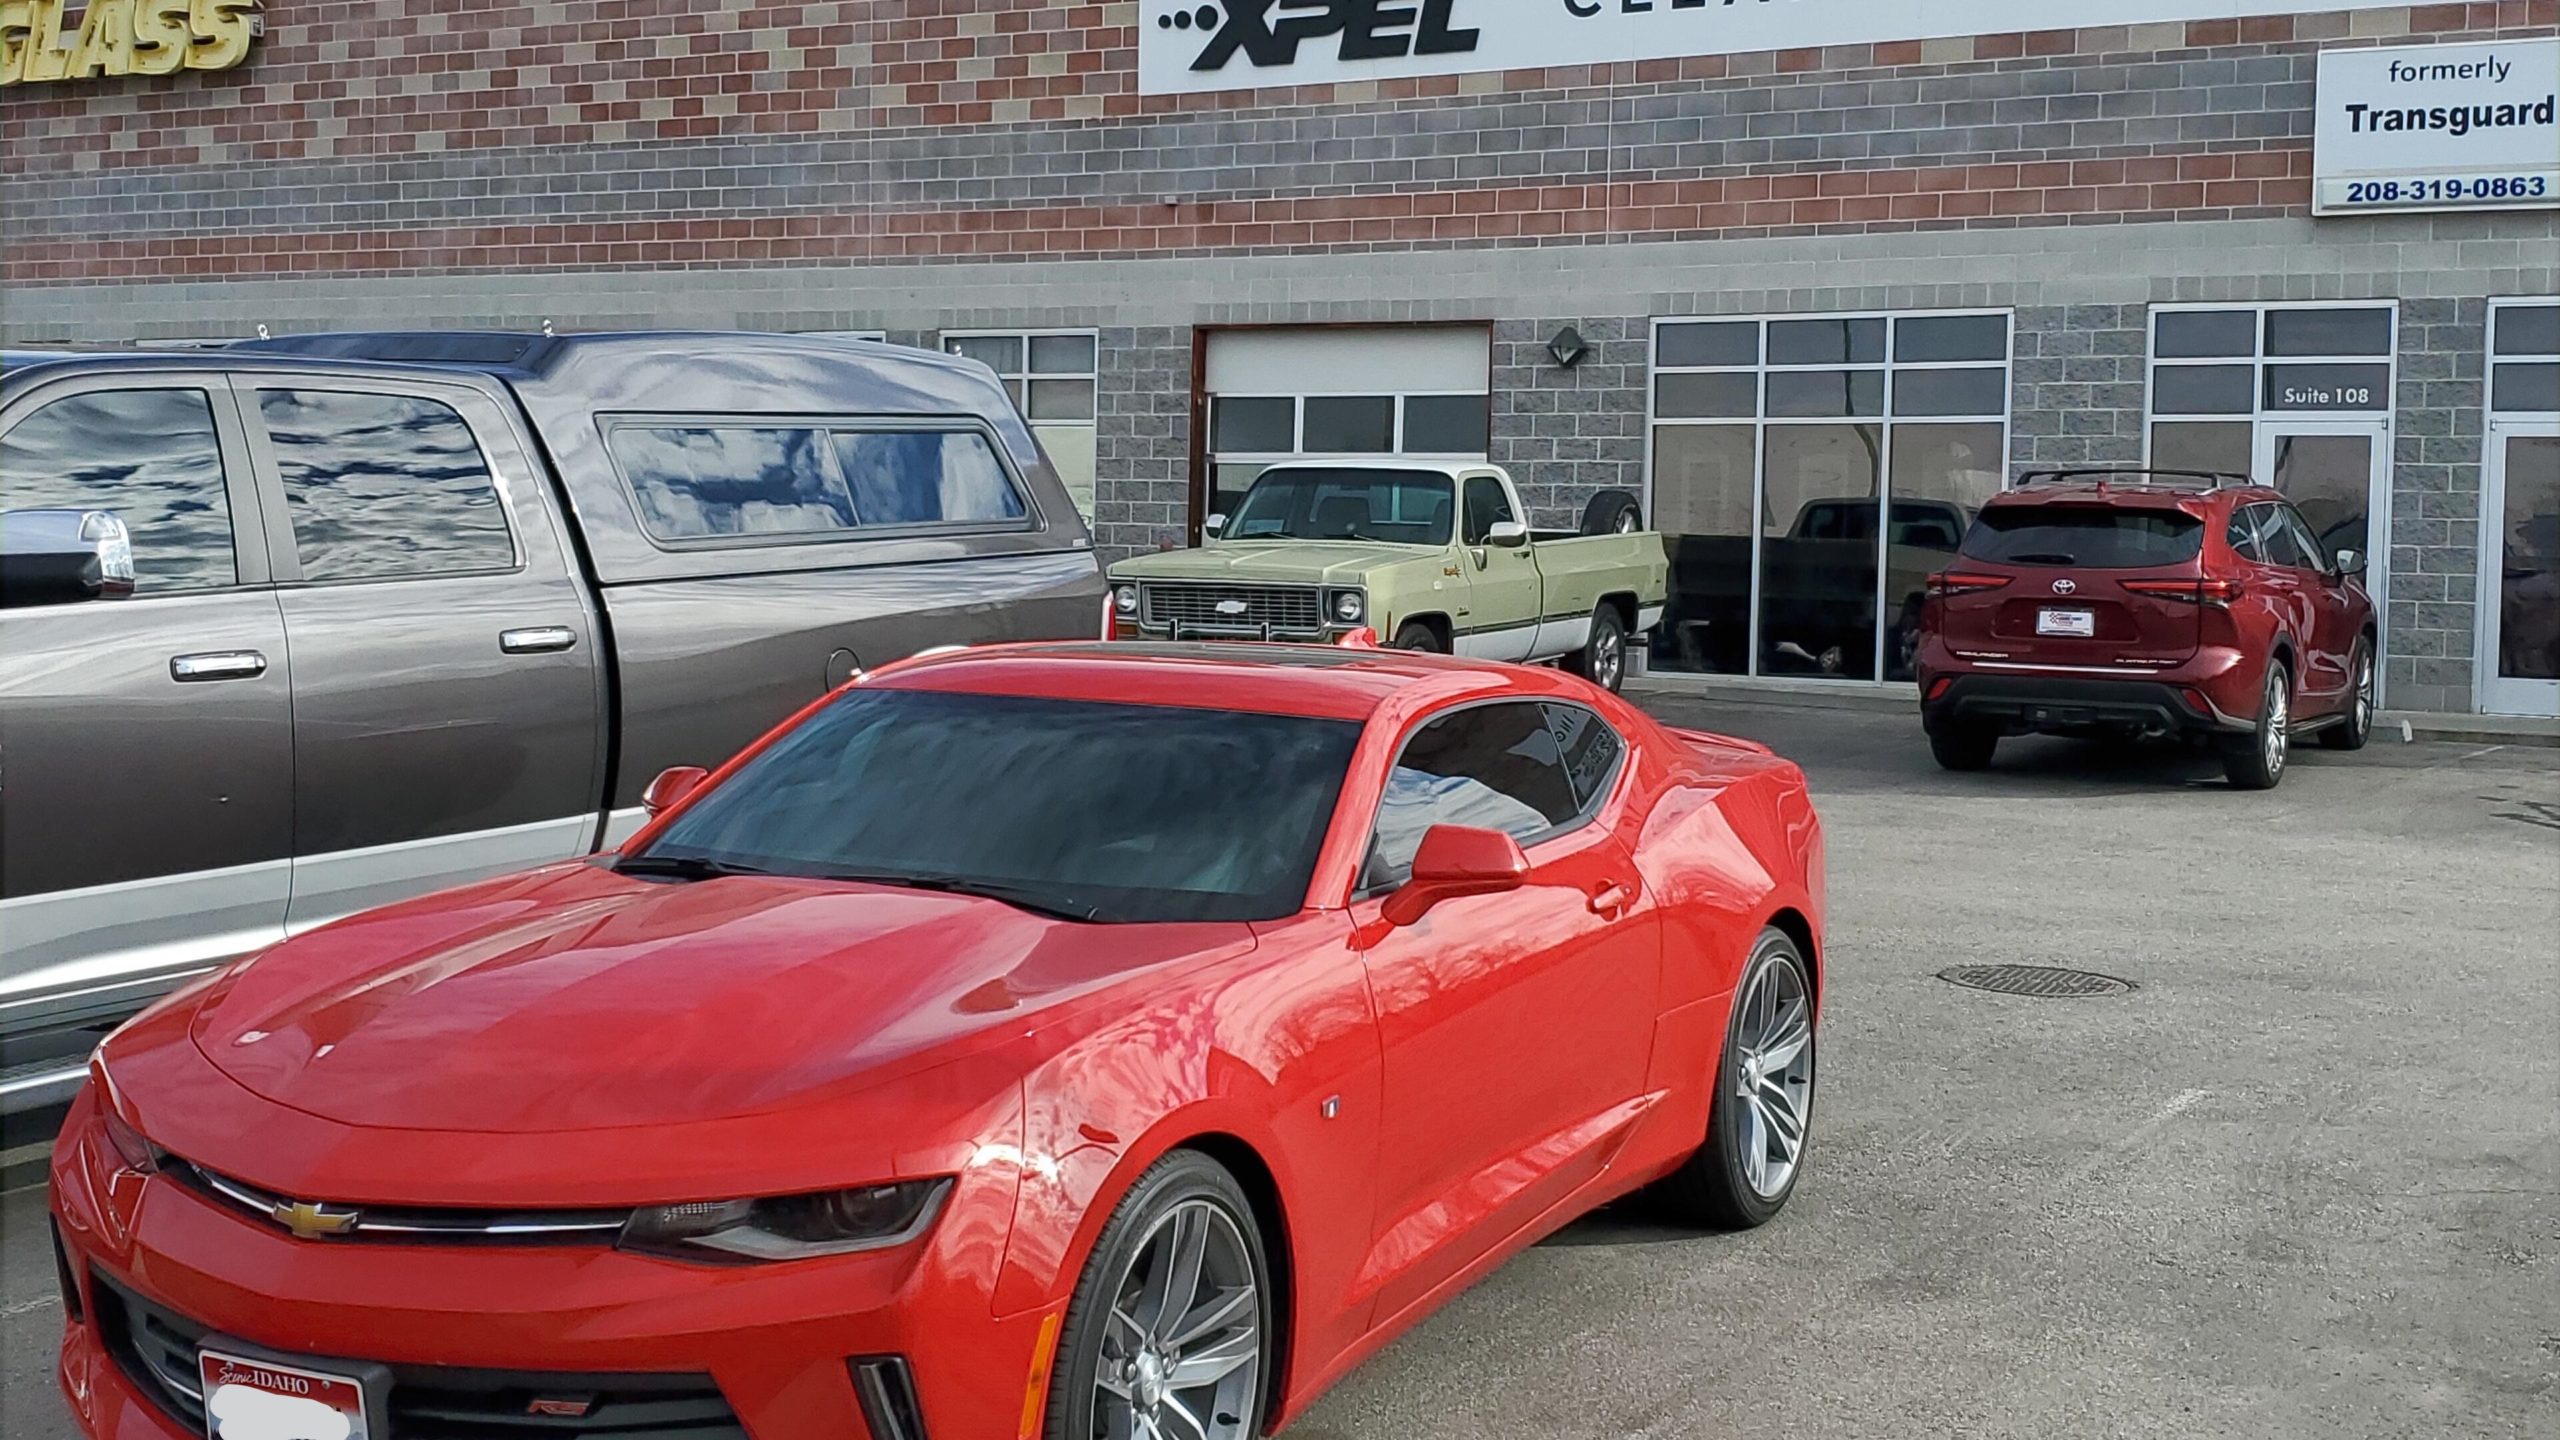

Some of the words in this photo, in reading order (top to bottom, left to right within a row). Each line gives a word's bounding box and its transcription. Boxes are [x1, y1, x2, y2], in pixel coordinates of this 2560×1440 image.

[1188, 0, 1480, 71] XPEL
[2389, 54, 2511, 83] formerly
[2345, 94, 2555, 136] Transguard
[2346, 176, 2546, 203] 208-319-0863
[2284, 387, 2329, 404] Suite
[2336, 388, 2369, 404] 108
[251, 1370, 309, 1394] IDAHO
